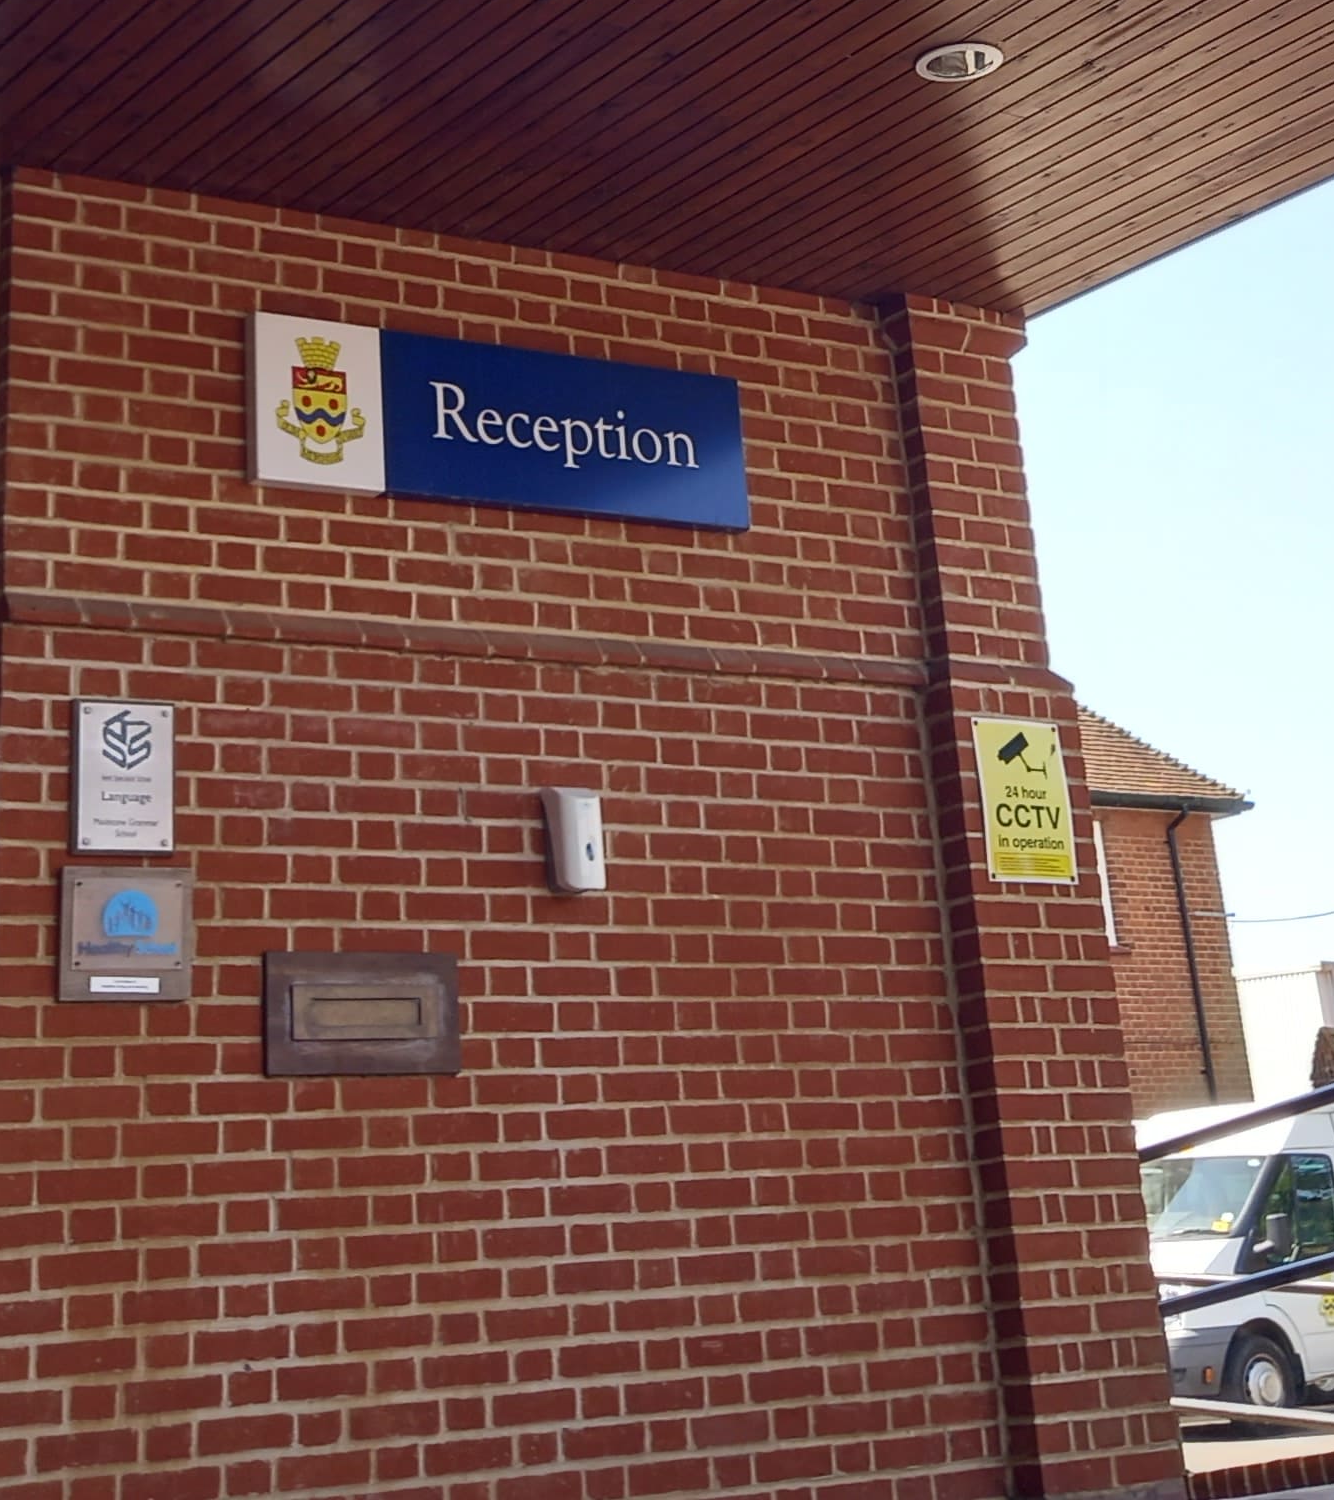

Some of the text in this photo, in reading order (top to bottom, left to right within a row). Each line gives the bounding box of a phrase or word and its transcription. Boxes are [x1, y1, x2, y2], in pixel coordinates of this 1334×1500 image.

[429, 381, 699, 469] Reception
[101, 791, 152, 805] Language
[1004, 785, 1046, 800] 24 hour
[996, 803, 1060, 829] CCTV
[998, 835, 1064, 850] in operation
